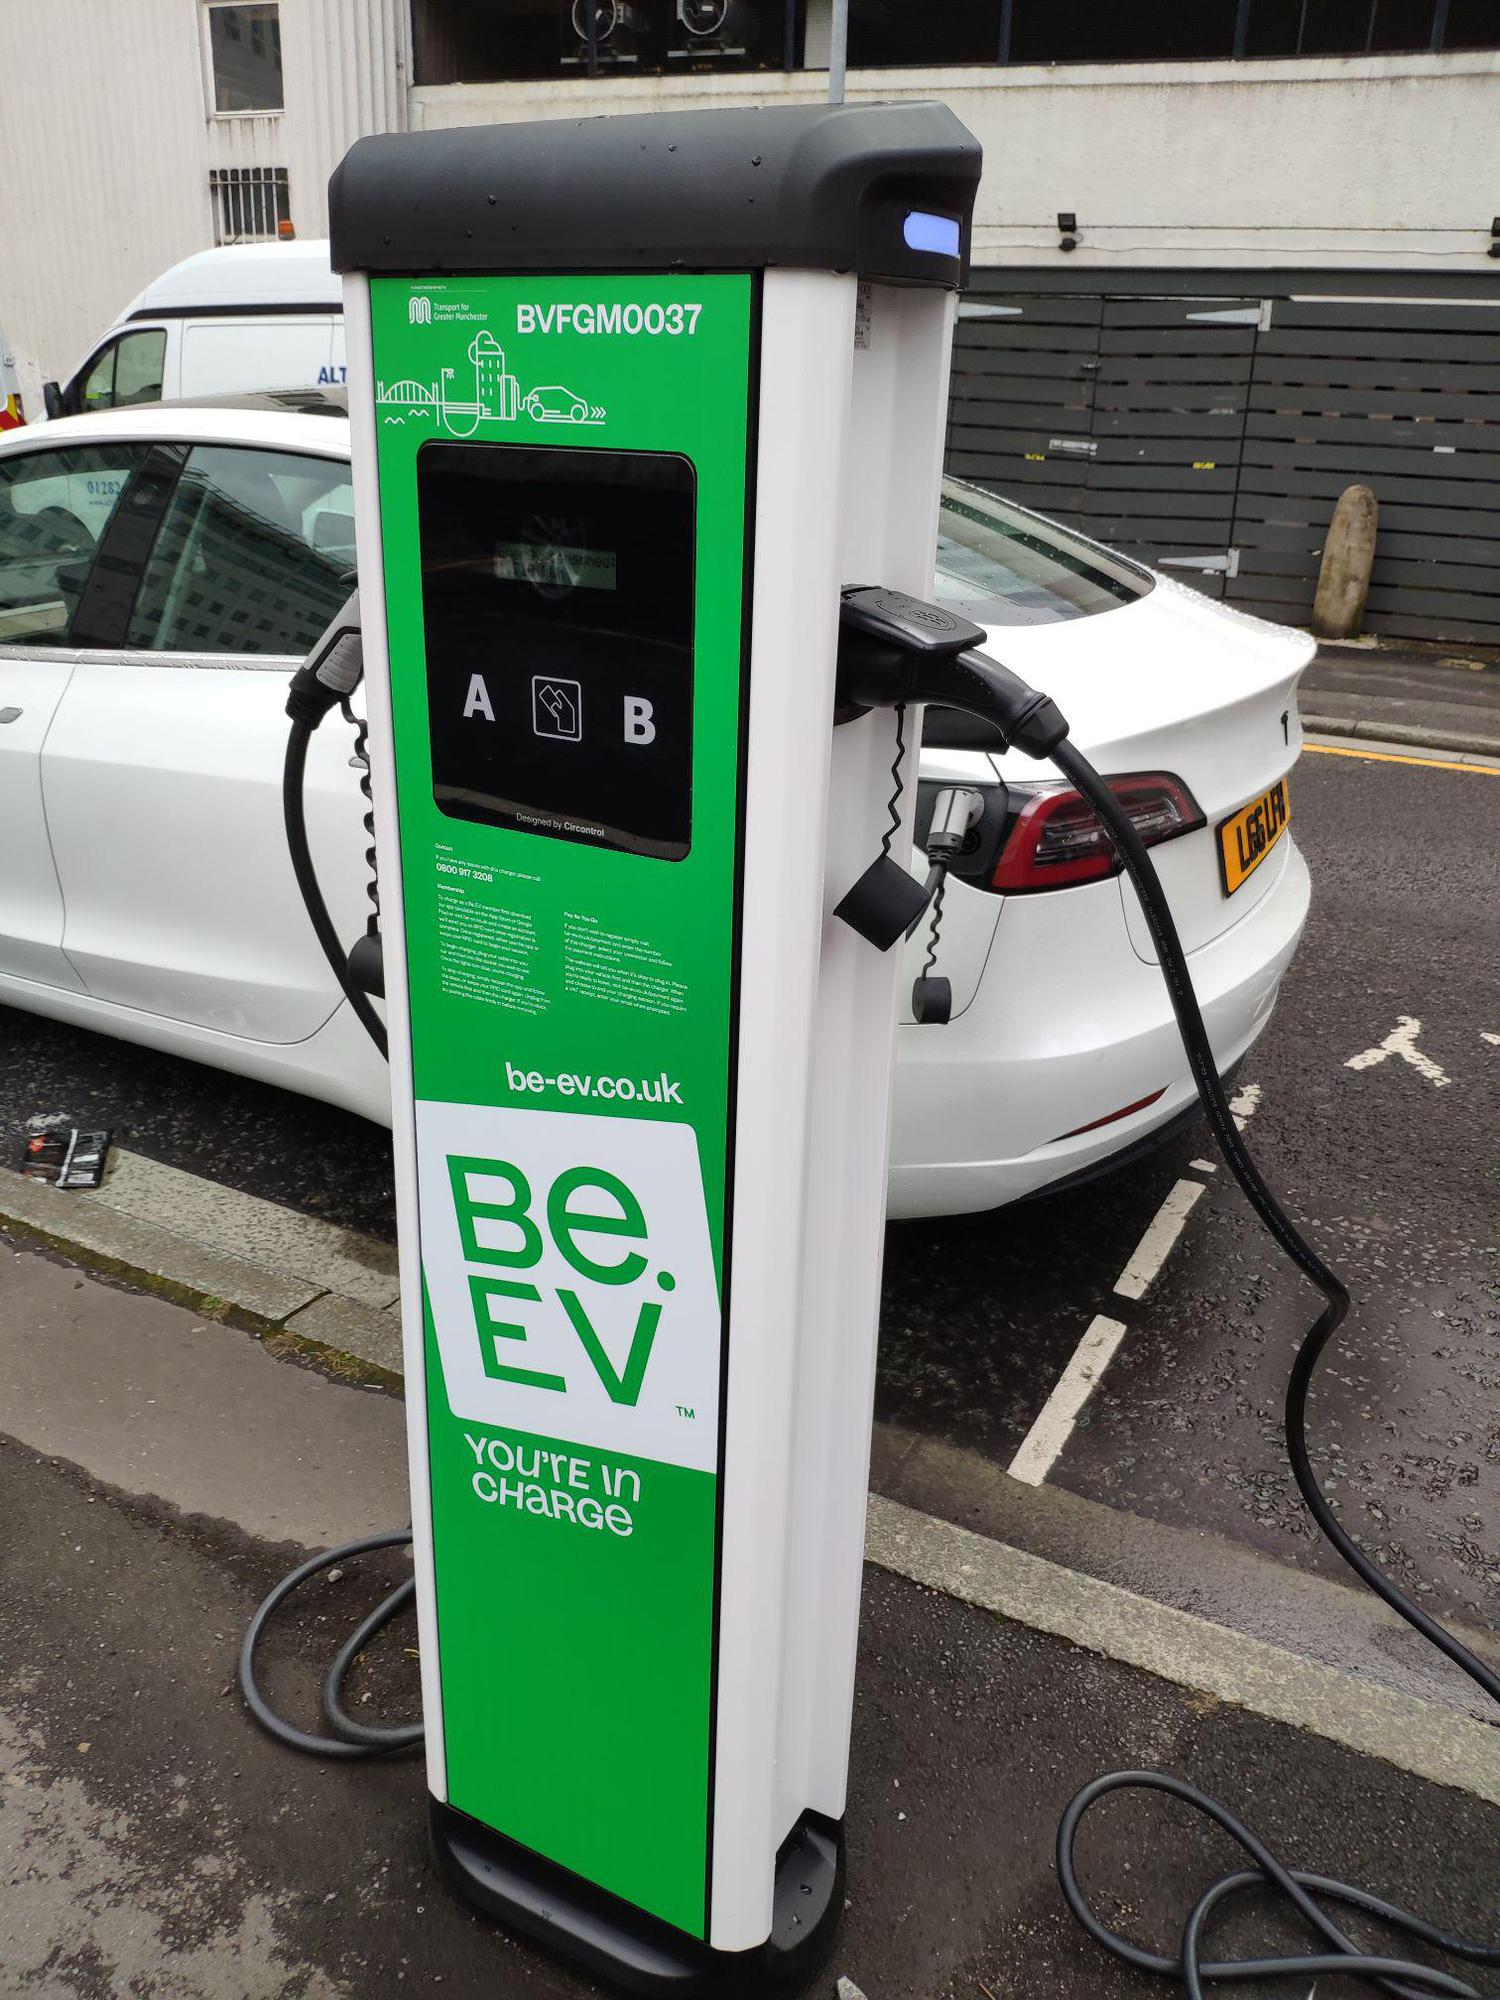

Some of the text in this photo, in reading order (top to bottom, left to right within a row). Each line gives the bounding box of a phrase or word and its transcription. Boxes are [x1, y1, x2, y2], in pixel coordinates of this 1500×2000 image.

[433, 302, 470, 312] Transport for
[433, 312, 488, 322] Greater Manchester
[462, 673, 496, 722] A
[624, 695, 656, 745] B
[516, 812, 605, 837] Designed by Circontrol
[505, 1061, 684, 1105] be-ev.co.uk
[467, 1274, 662, 1407] EV
